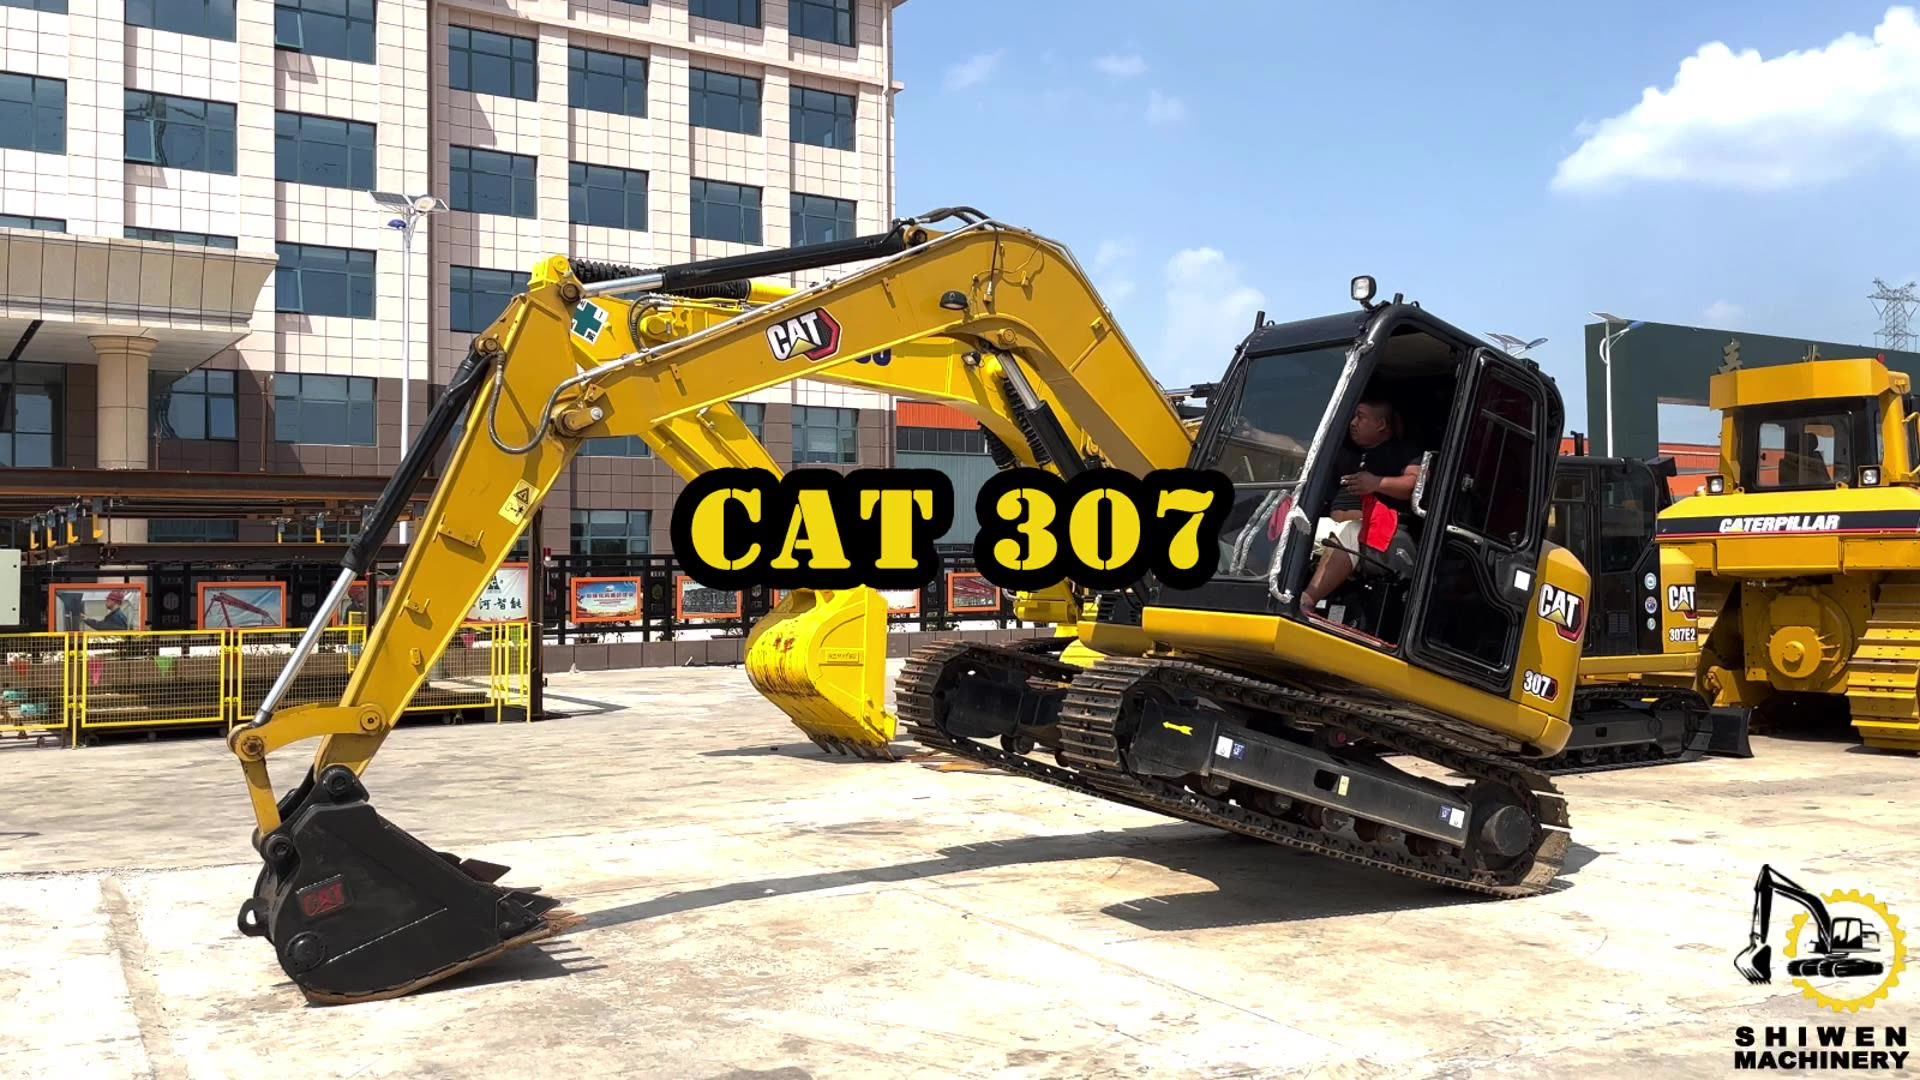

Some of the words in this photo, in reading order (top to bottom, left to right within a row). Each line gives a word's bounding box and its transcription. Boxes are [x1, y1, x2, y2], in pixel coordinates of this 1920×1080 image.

[766, 311, 822, 360] CAT
[1719, 514, 1841, 534] CATERPILLAR
[1539, 584, 1580, 628] CAT
[1668, 586, 1696, 611] CAT
[1669, 628, 1697, 642] 307E2
[1523, 670, 1552, 697] 307
